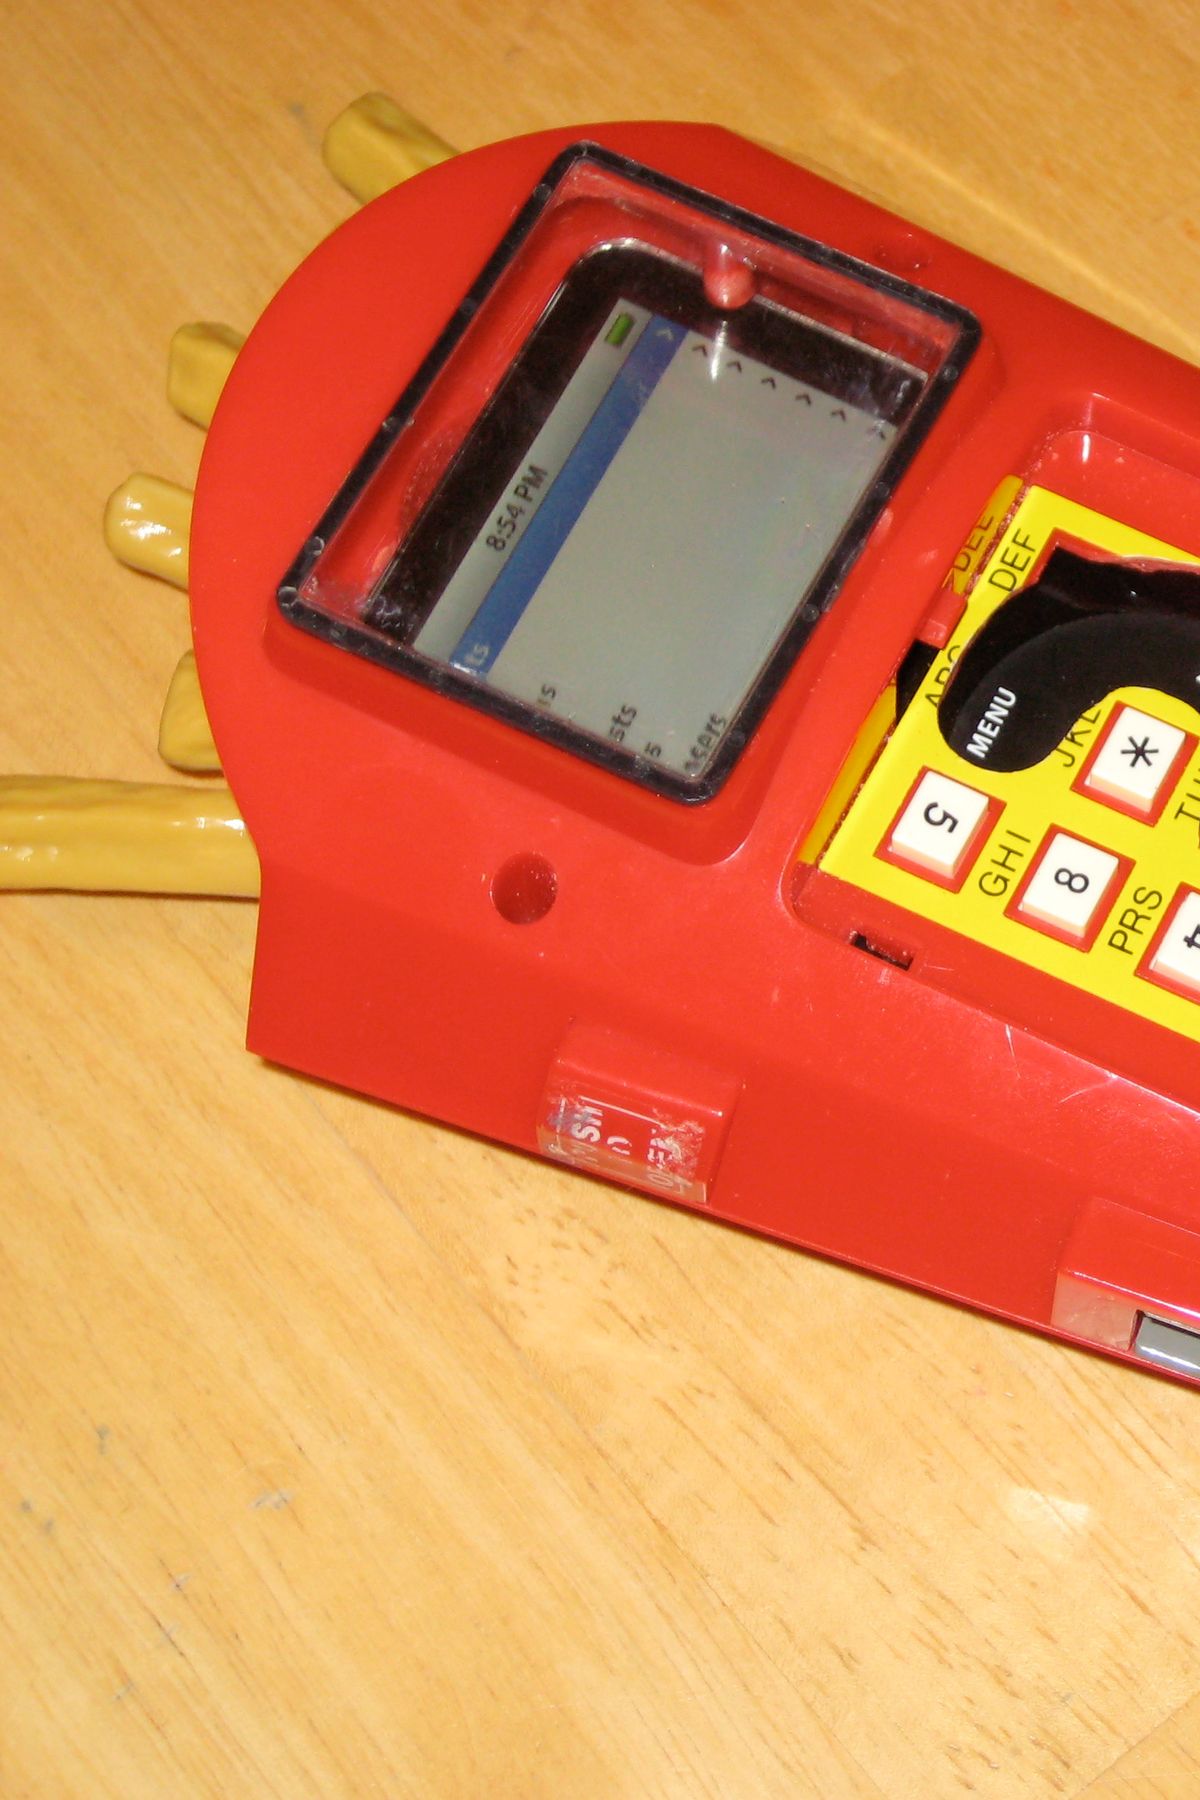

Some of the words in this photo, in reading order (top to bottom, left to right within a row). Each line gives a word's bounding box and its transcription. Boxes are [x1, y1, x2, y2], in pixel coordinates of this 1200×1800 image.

[484, 503, 524, 552] 8:54
[513, 464, 548, 503] PM
[988, 529, 1035, 592] DEF
[966, 686, 1015, 758] MENU
[1061, 705, 1101, 769] JKL
[923, 802, 958, 832] 5
[978, 830, 1030, 896] GHI
[1054, 868, 1089, 893] 8
[1107, 886, 1162, 954] PRS
